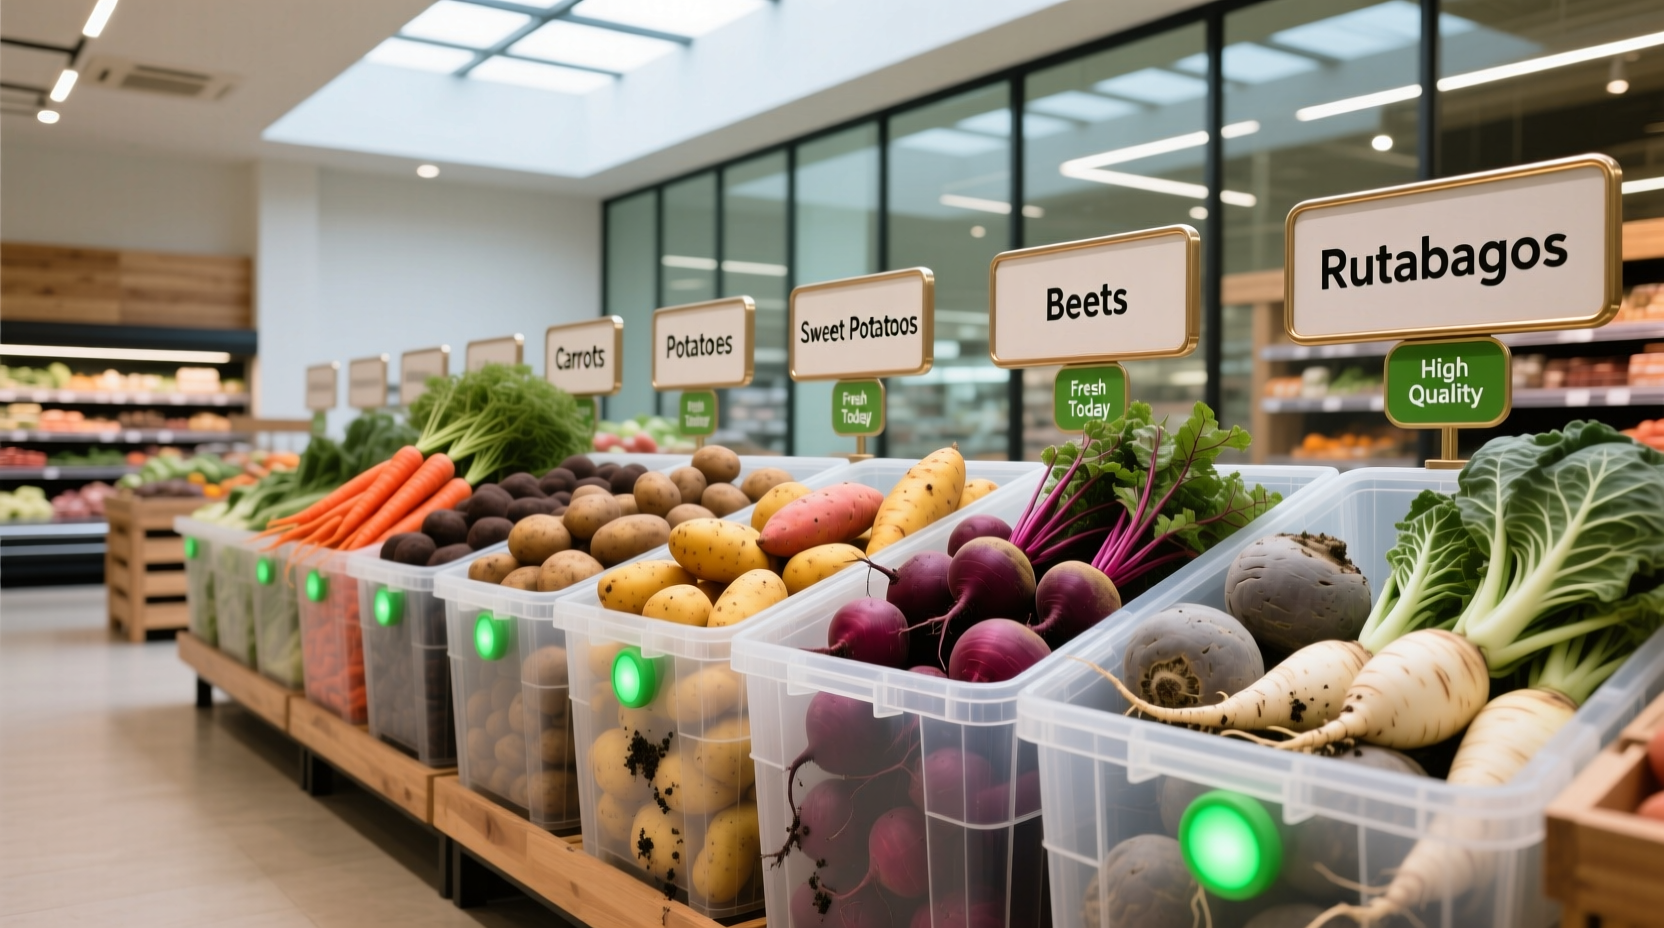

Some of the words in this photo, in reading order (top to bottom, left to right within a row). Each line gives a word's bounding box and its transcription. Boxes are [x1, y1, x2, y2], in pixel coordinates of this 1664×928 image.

[1321, 233, 1568, 290] Rutabagos
[1047, 284, 1128, 321] Beets
[801, 320, 845, 343] Sweet
[556, 345, 606, 370] Carrots
[666, 333, 733, 359] Potatoes
[1421, 357, 1468, 383] High
[1071, 378, 1106, 397] Fresh
[1408, 383, 1483, 409] Quality
[1068, 398, 1110, 421] Today
